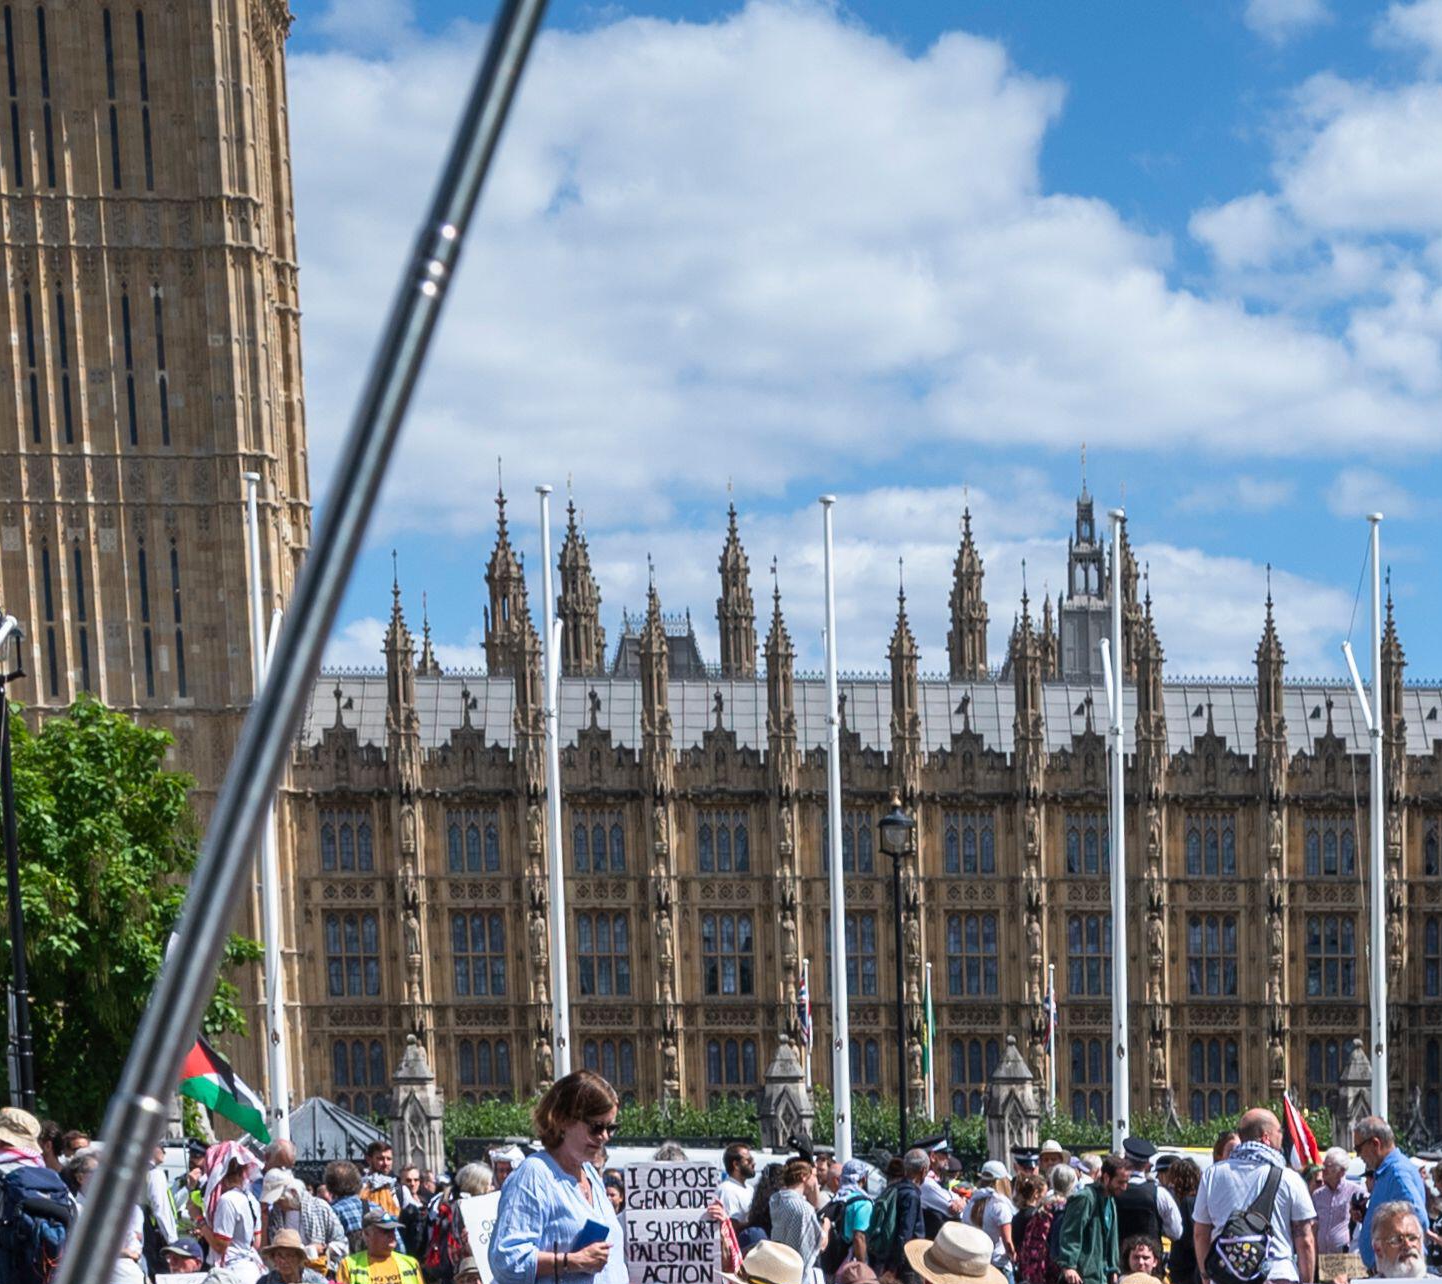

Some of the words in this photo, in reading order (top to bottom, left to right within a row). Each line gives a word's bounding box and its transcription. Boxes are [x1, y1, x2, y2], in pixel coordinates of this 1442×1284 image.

[627, 1168, 638, 1190] I
[646, 1166, 718, 1190] OPPOSE
[628, 1189, 715, 1210] GENOCIDE
[627, 1220, 638, 1242] I
[647, 1218, 719, 1243] SUPPORT
[628, 1240, 715, 1264] PALESTINE
[642, 1263, 714, 1284] ACTION
